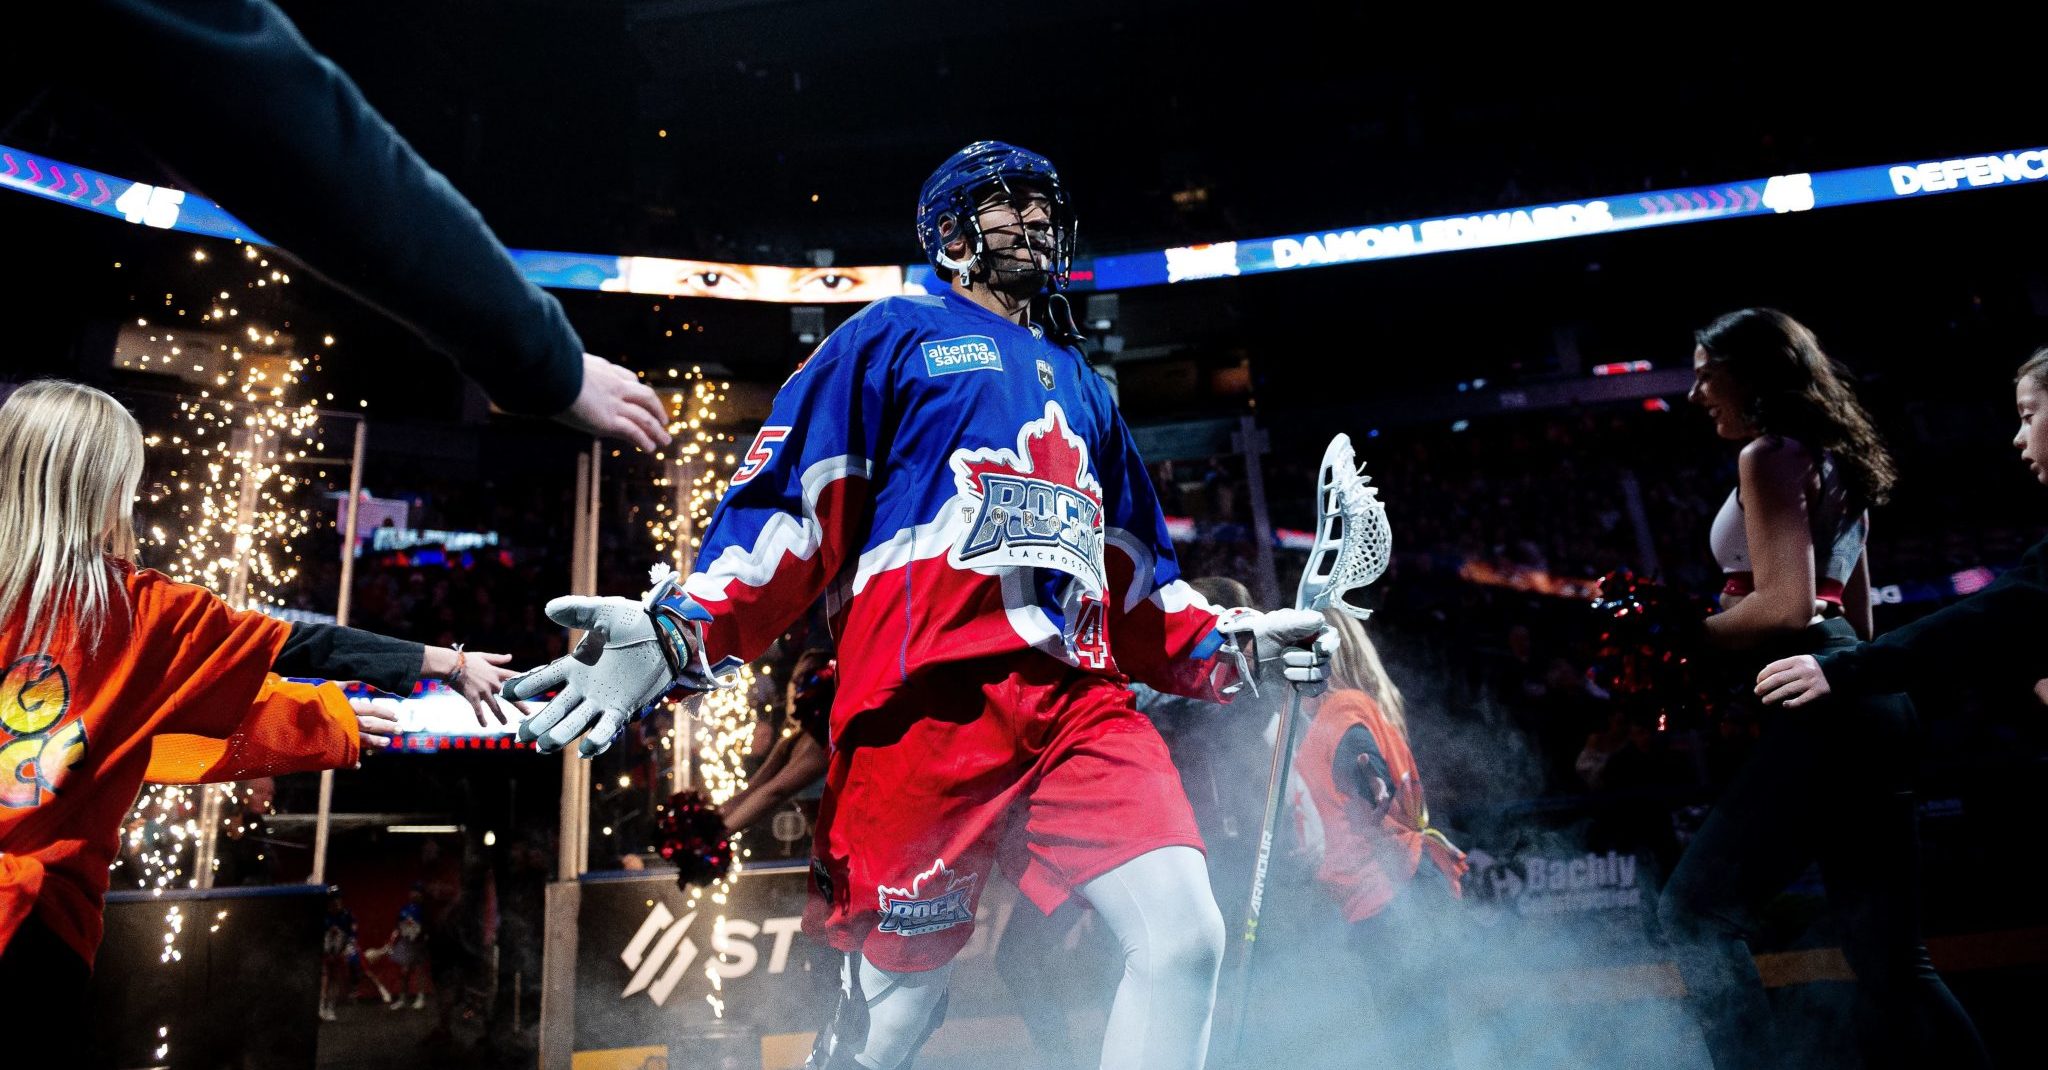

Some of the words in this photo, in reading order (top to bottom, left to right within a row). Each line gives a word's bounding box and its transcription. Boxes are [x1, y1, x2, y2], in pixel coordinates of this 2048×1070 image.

[1273, 223, 1417, 268] DAMON
[1420, 200, 1614, 252] EDWARDS
[928, 342, 989, 359] alterna
[934, 350, 997, 367] savings
[960, 473, 1103, 570] ROCK
[1250, 829, 1274, 918] ARMOUR
[881, 887, 972, 931] ROCK
